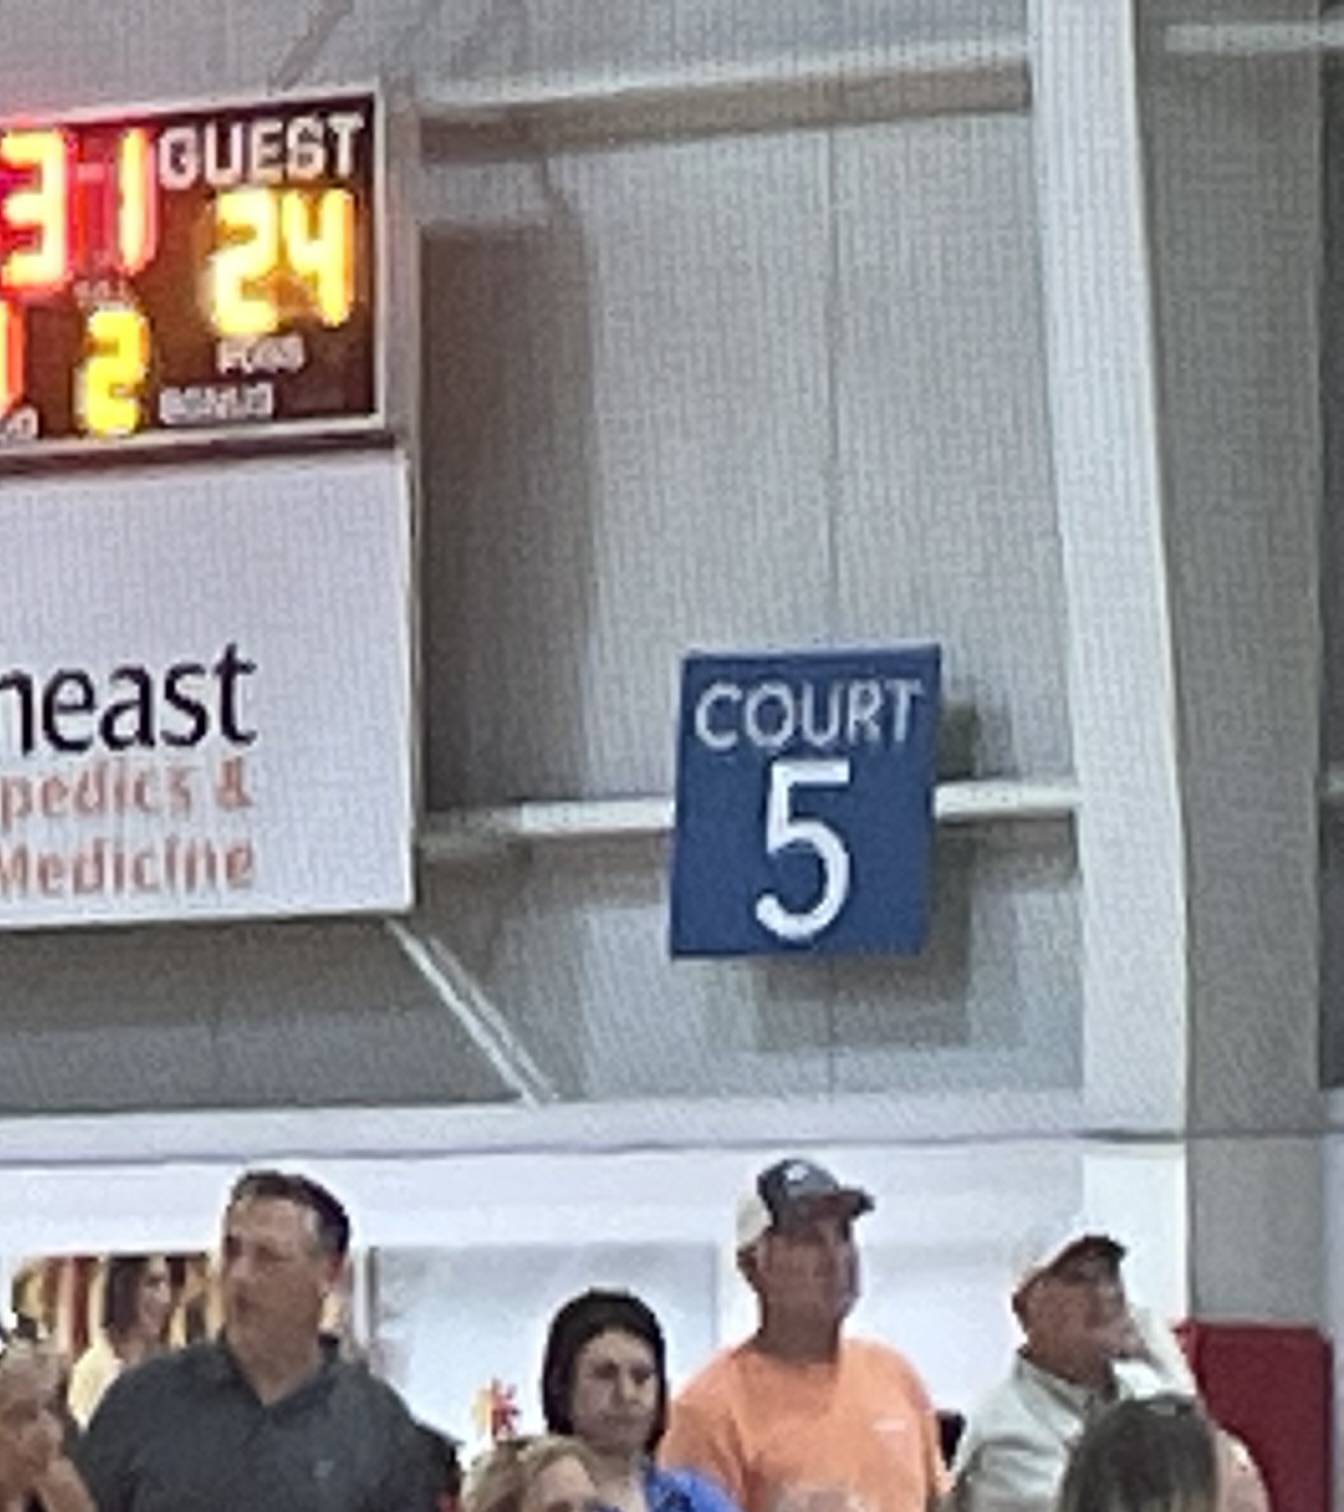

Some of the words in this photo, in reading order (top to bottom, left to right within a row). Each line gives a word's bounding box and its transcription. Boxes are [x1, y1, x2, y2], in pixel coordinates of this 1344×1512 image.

[157, 113, 366, 190] GUEST
[207, 185, 357, 336] 24
[74, 307, 149, 438] 2
[694, 676, 925, 749] COURT
[214, 756, 253, 811] &
[755, 758, 852, 940] 5
